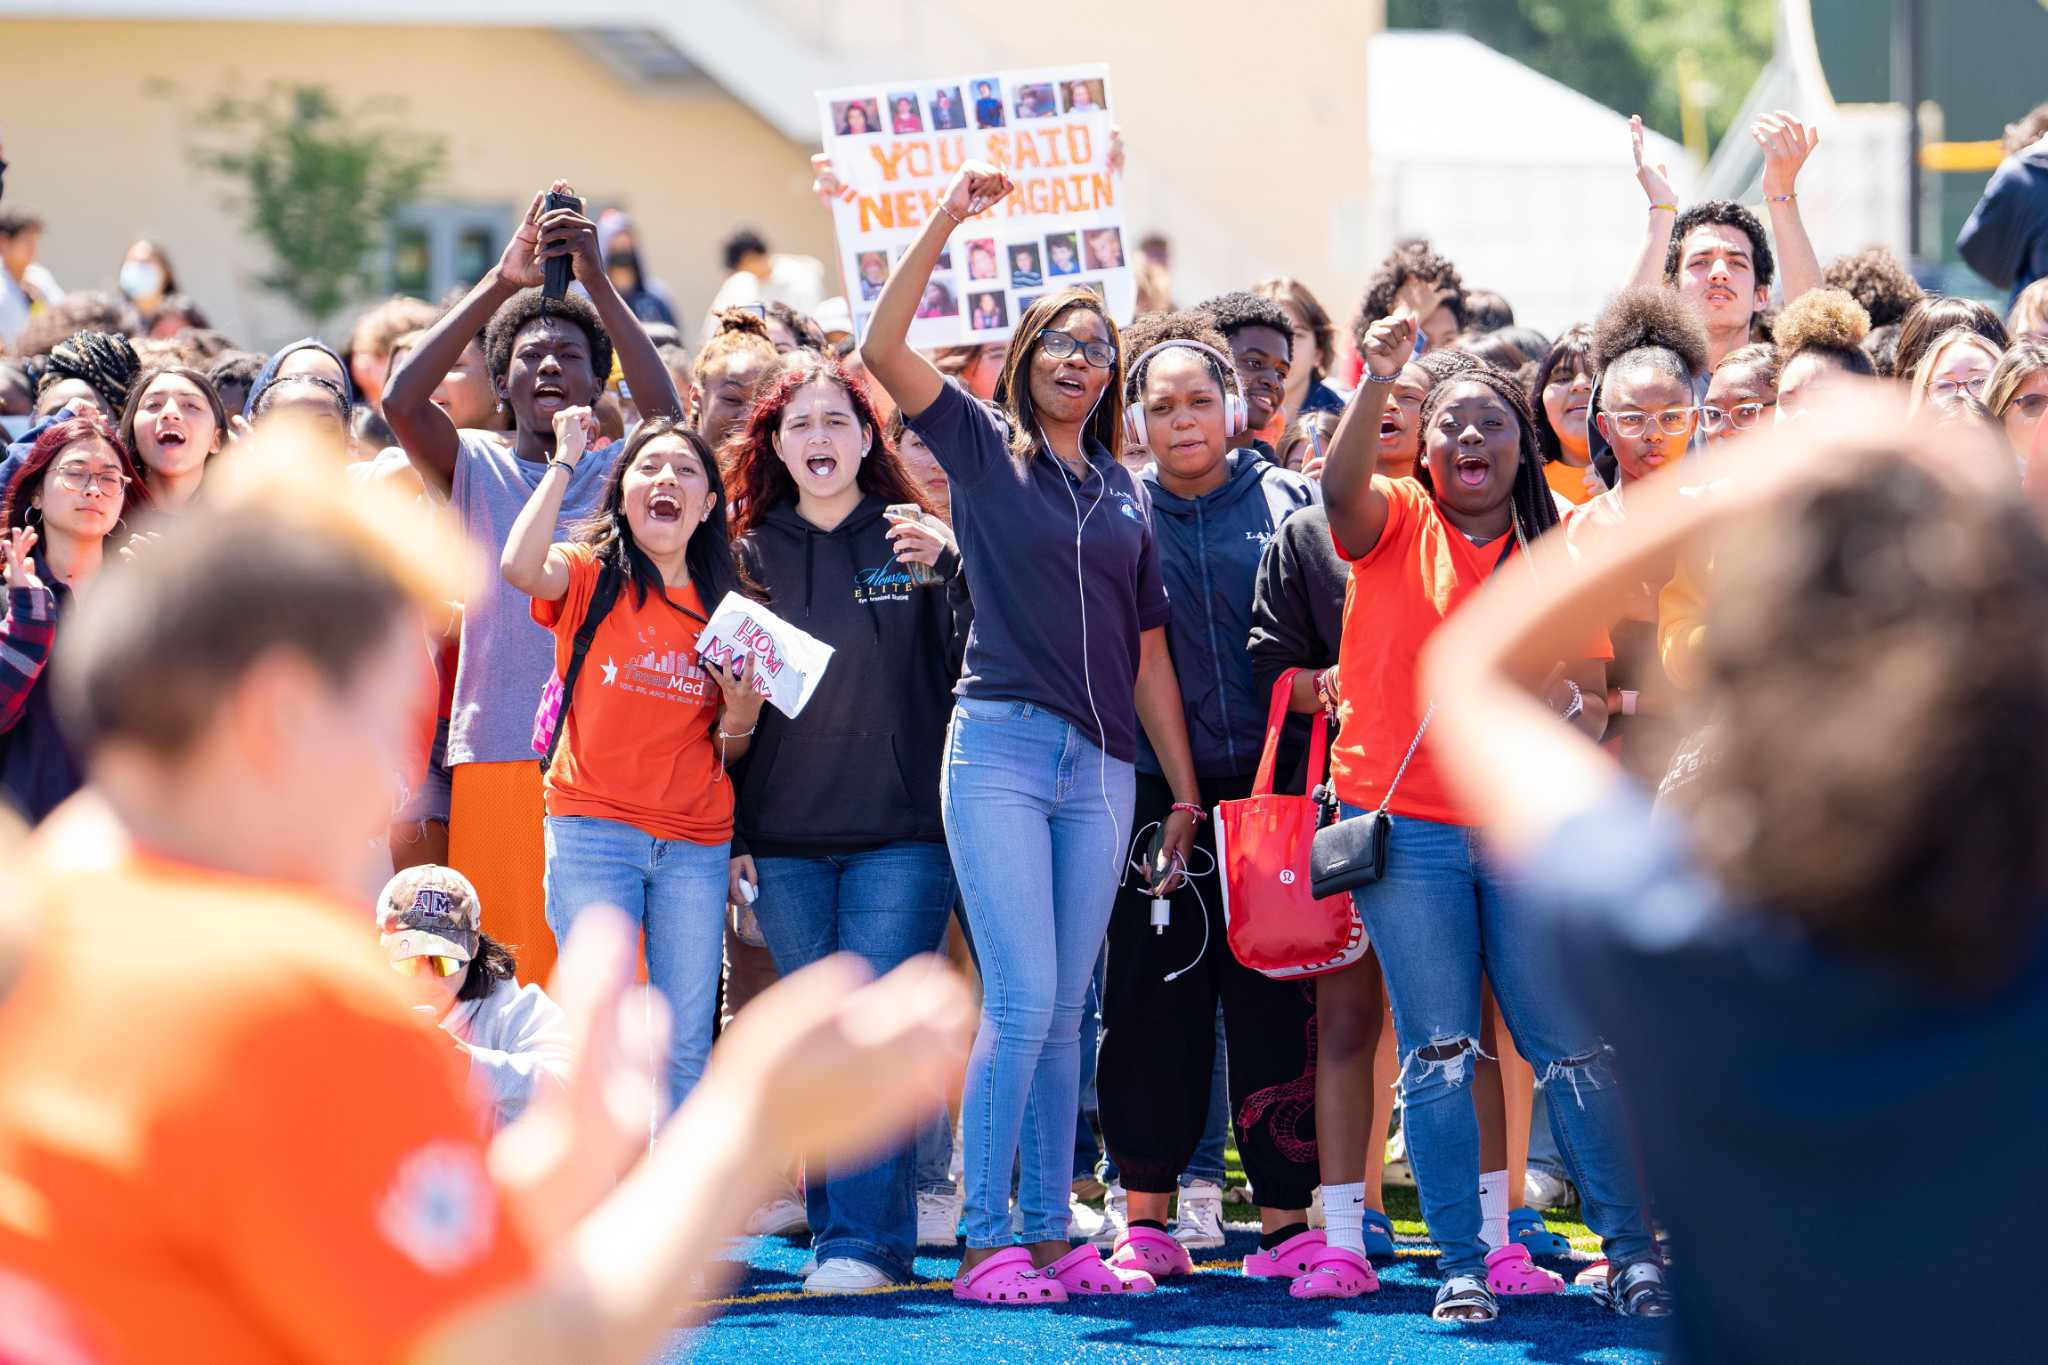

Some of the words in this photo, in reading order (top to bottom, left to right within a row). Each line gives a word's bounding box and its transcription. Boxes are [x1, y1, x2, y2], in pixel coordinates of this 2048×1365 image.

[869, 135, 966, 182] YOU
[986, 123, 1093, 171] SAID
[858, 185, 997, 232] NEV
[1008, 171, 1115, 218] AGAIN
[854, 583, 912, 598] ELITE
[733, 616, 784, 679] HOW
